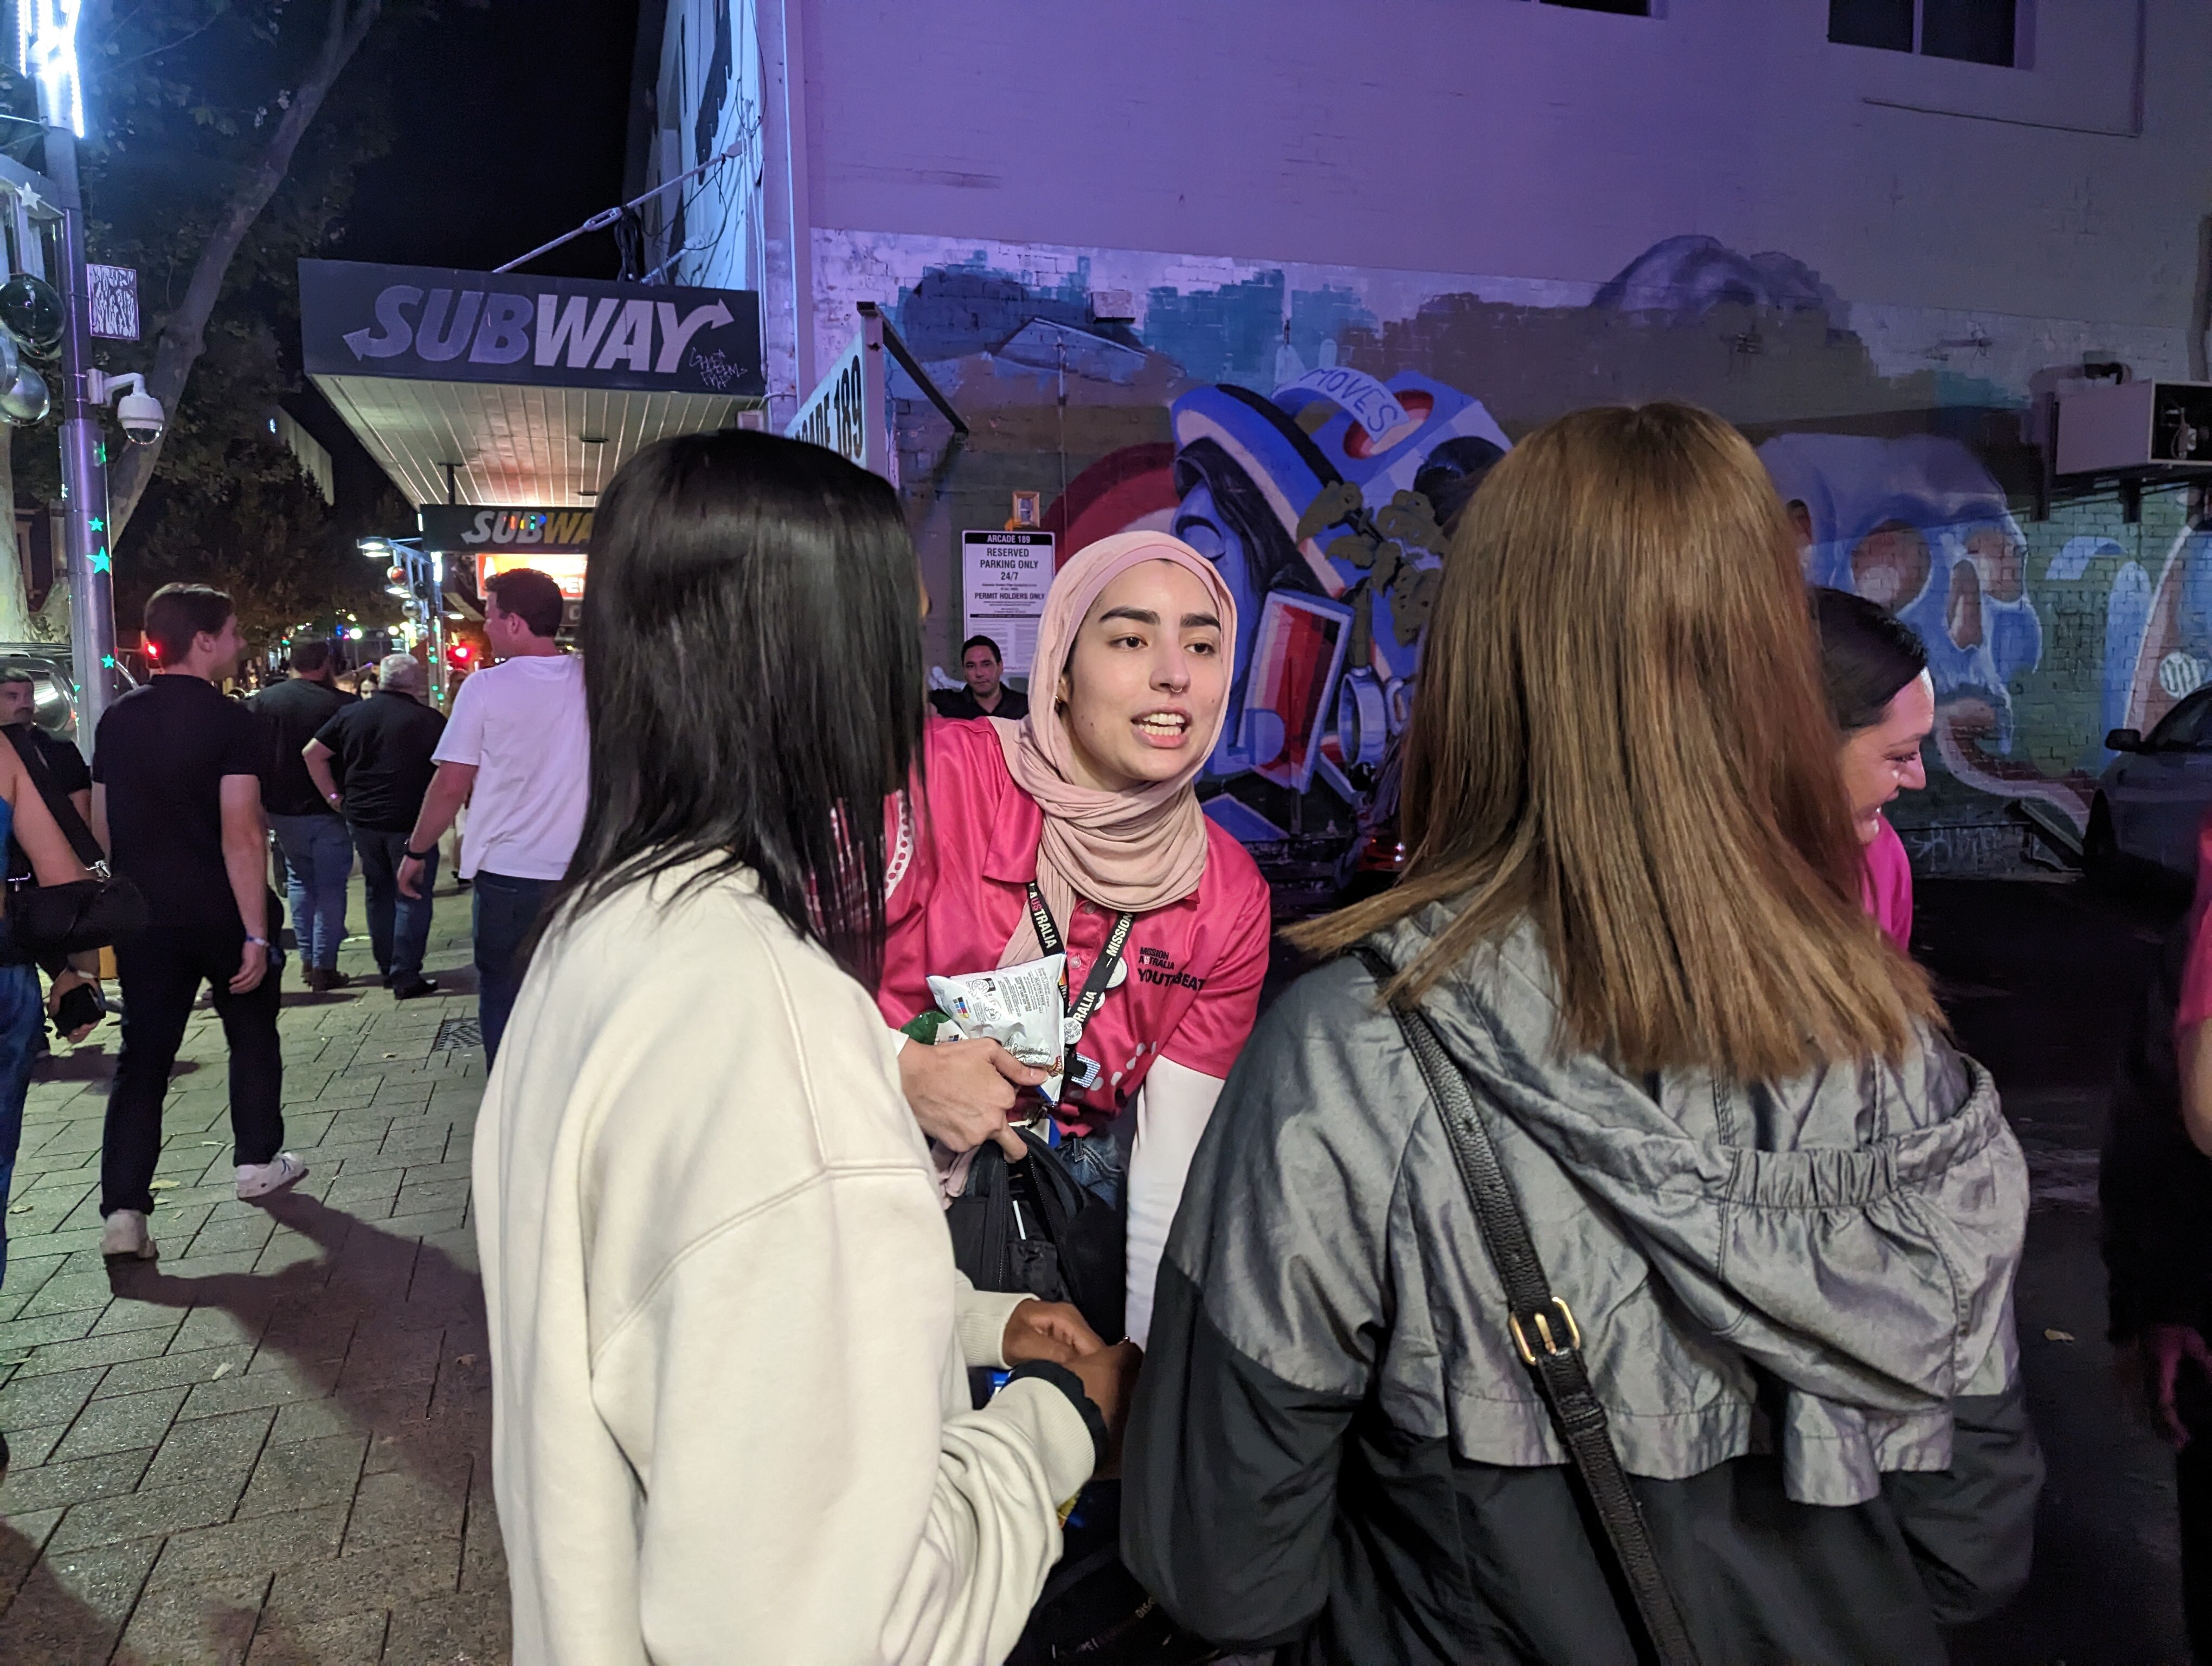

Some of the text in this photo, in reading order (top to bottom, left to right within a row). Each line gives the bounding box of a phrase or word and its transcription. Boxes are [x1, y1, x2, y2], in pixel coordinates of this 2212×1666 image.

[343, 285, 735, 374] SUBWAY
[834, 355, 863, 461] 189
[1300, 368, 1398, 432] MOVES
[461, 510, 595, 544] SUBWA
[987, 535, 1031, 543] ARCADE 189
[980, 560, 1038, 569] PARKING ONLY
[987, 548, 1029, 557] RESERVED
[1001, 572, 1019, 580] 24/7
[1030, 891, 1057, 949] AUSTRALIA
[1106, 912, 1133, 957] MISSION
[1140, 947, 1169, 960] MISSION
[1034, 977, 1042, 994] GLUTEN
[1137, 968, 1206, 991] YOUTBEAT
[1072, 991, 1097, 1023] RALIA
